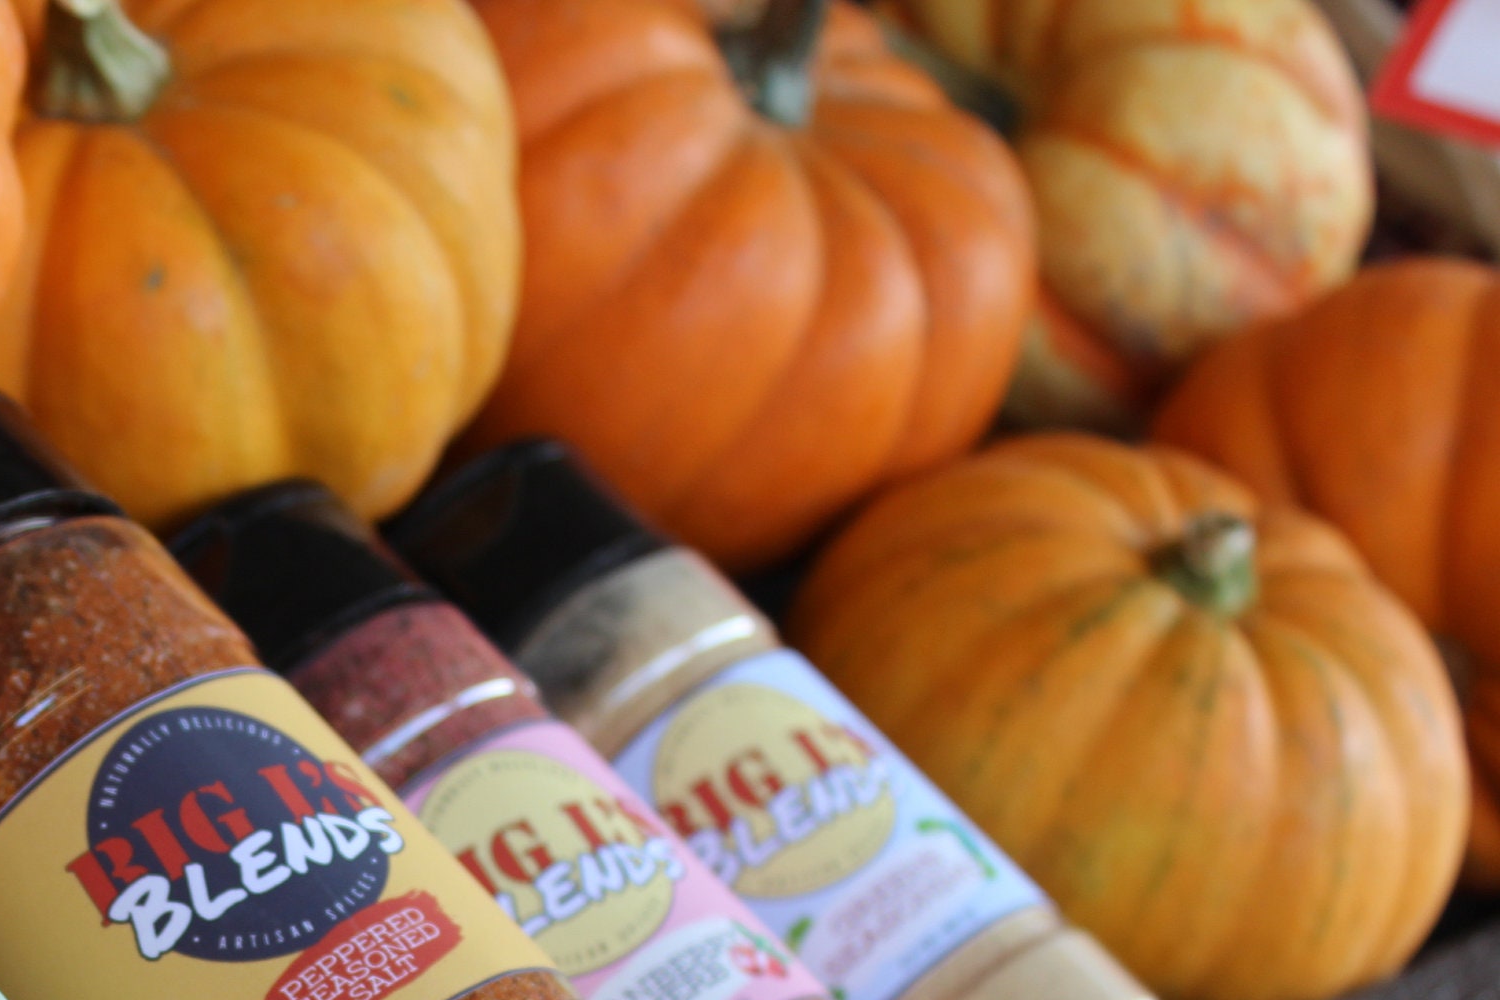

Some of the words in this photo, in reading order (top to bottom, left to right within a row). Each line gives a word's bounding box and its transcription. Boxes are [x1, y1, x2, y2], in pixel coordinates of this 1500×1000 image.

[99, 723, 171, 807] NATURALLY
[178, 716, 281, 745] DELICIOUS
[65, 780, 255, 927] BIG
[107, 806, 405, 962] BLENDS
[457, 818, 554, 895] IG
[495, 836, 686, 938] LENDS
[218, 920, 315, 949] ARTISAN
[325, 872, 377, 920] SPICES
